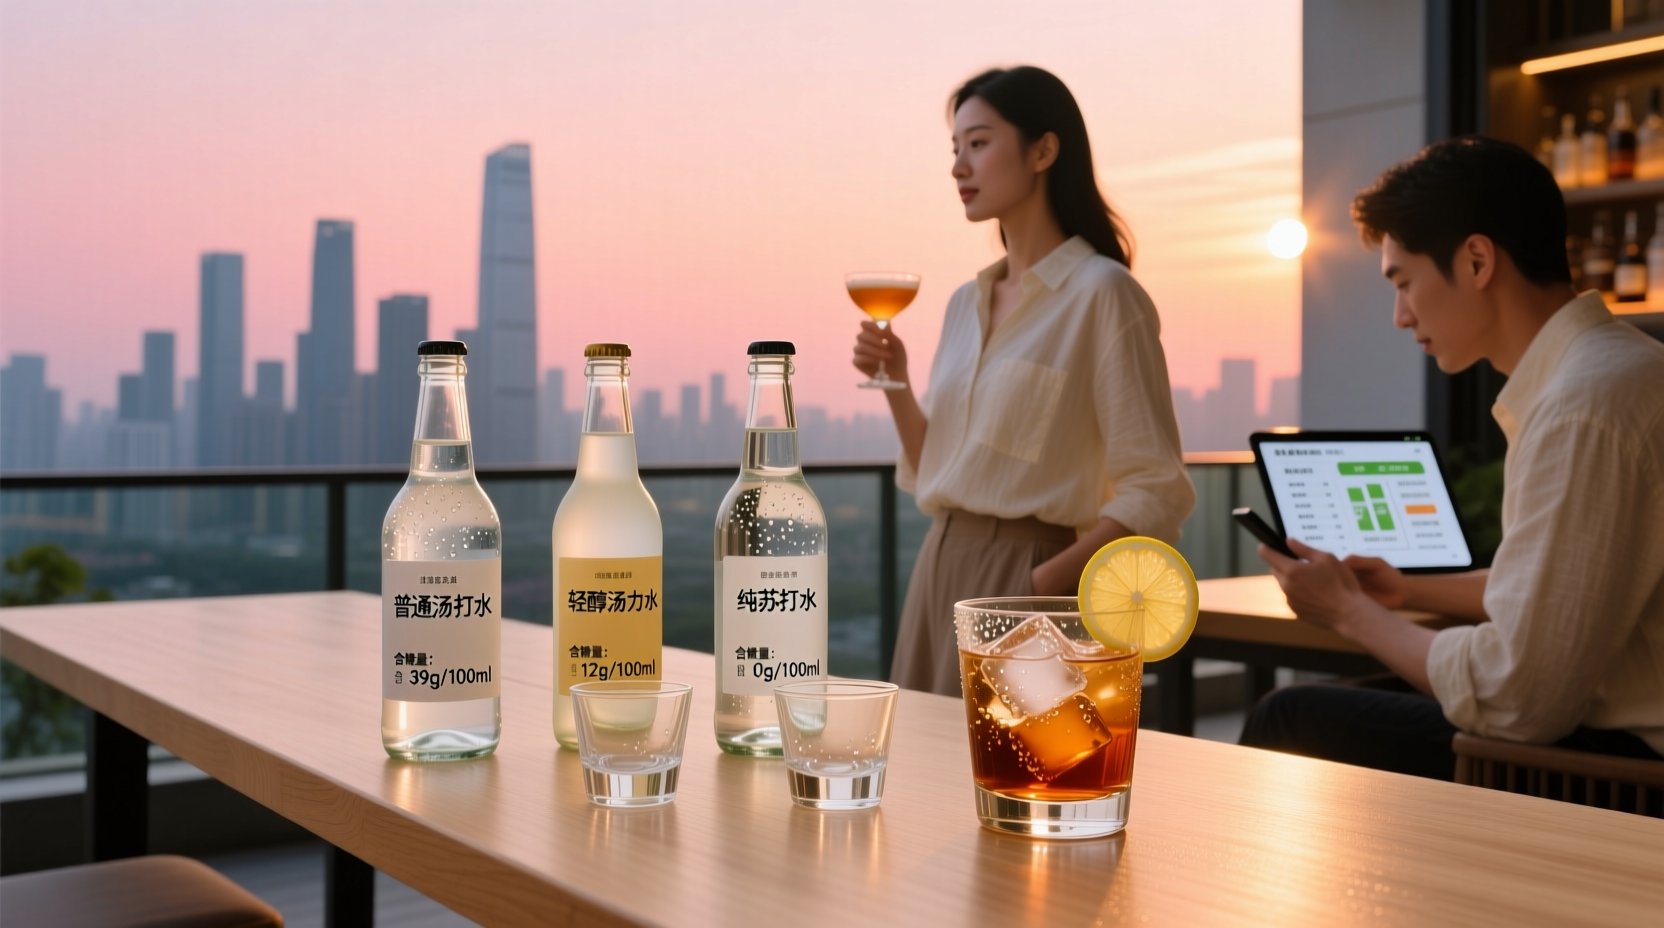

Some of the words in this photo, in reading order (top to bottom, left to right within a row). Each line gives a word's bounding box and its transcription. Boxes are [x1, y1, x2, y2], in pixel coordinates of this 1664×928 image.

[394, 593, 492, 618] 普通汤打水
[568, 588, 658, 613] 轻醇汤力水
[737, 588, 817, 612] 纯苏打水
[409, 665, 492, 690] 39g/100ml
[581, 659, 655, 681] 12g/100ml
[753, 659, 820, 682] 0g/100ml
